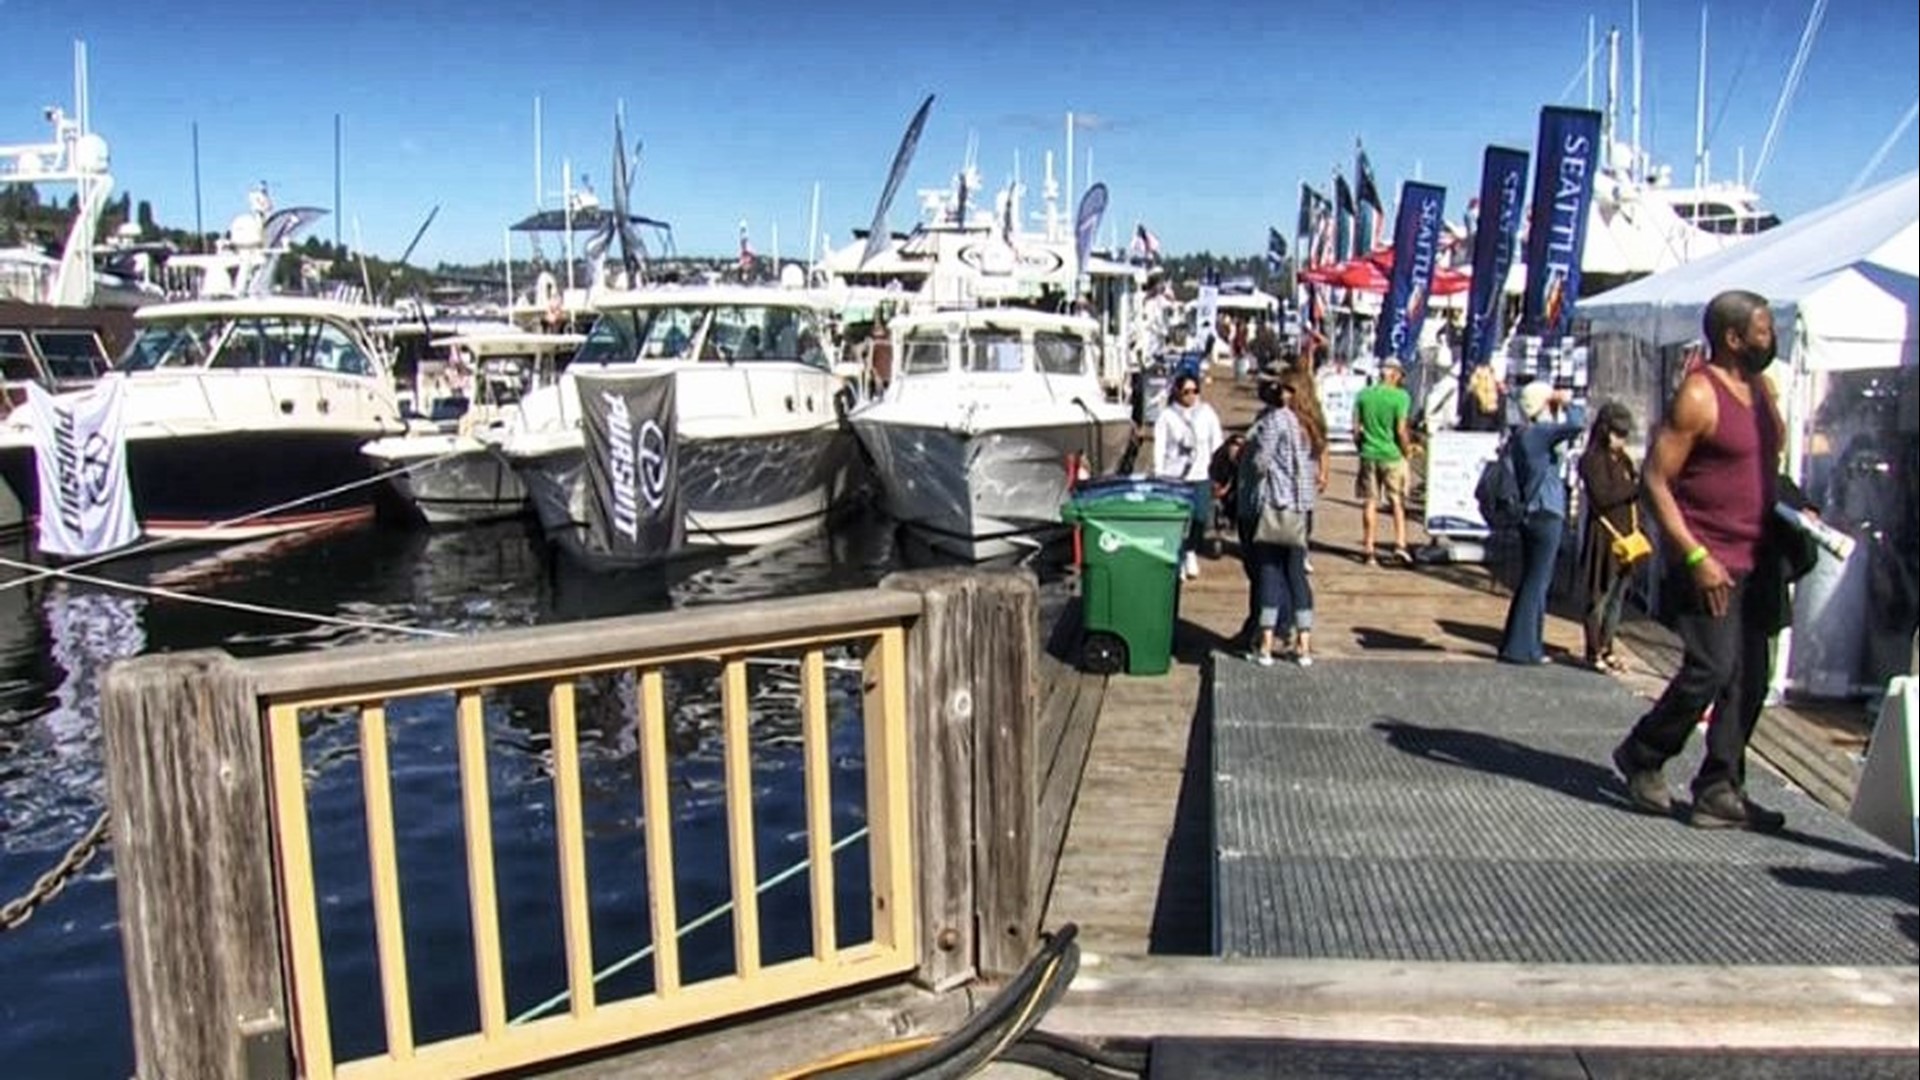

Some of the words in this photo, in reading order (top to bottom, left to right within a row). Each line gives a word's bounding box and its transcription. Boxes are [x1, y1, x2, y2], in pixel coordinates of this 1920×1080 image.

[1412, 197, 1438, 287] SEATTLE
[1547, 133, 1589, 281] SEATTLE
[54, 406, 84, 540] PURSUIT
[603, 391, 637, 543] PURSUIT
